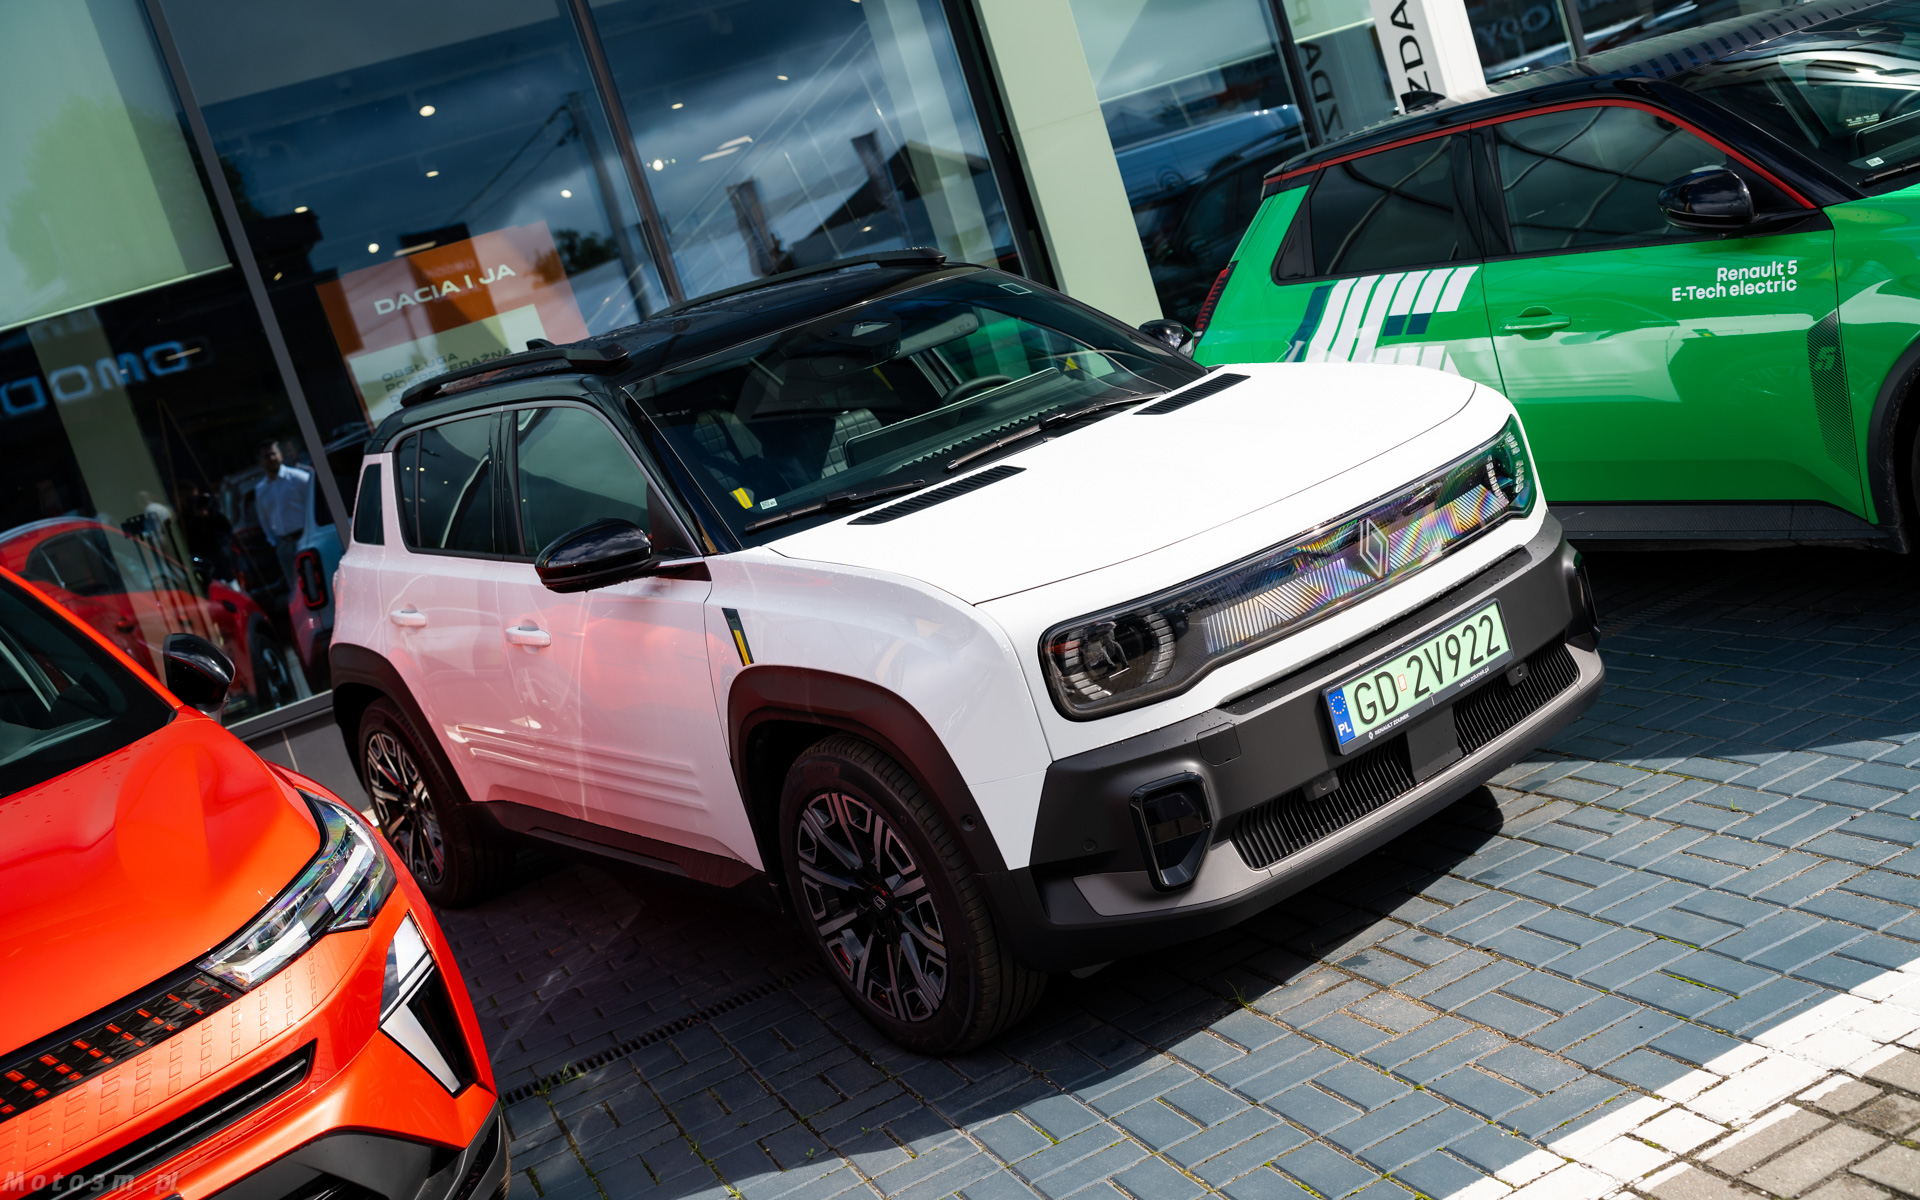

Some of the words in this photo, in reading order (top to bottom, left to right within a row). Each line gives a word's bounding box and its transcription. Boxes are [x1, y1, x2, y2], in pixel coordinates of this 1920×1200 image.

[1716, 260, 1784, 282] Renault
[1787, 259, 1798, 275] 5
[374, 279, 462, 316] DACIA
[463, 274, 473, 289] I
[478, 263, 517, 285] JA
[1671, 282, 1727, 302] E-Tech
[1729, 276, 1798, 296] electric
[381, 352, 459, 382] OBSŁUGA
[1353, 670, 1399, 726] GD
[1405, 614, 1501, 700] 2V922
[1459, 665, 1490, 688] www.zdunek.pl
[1337, 722, 1352, 737] PL
[1374, 721, 1393, 736] RENAULT
[1393, 712, 1410, 726] ZDUNEK
